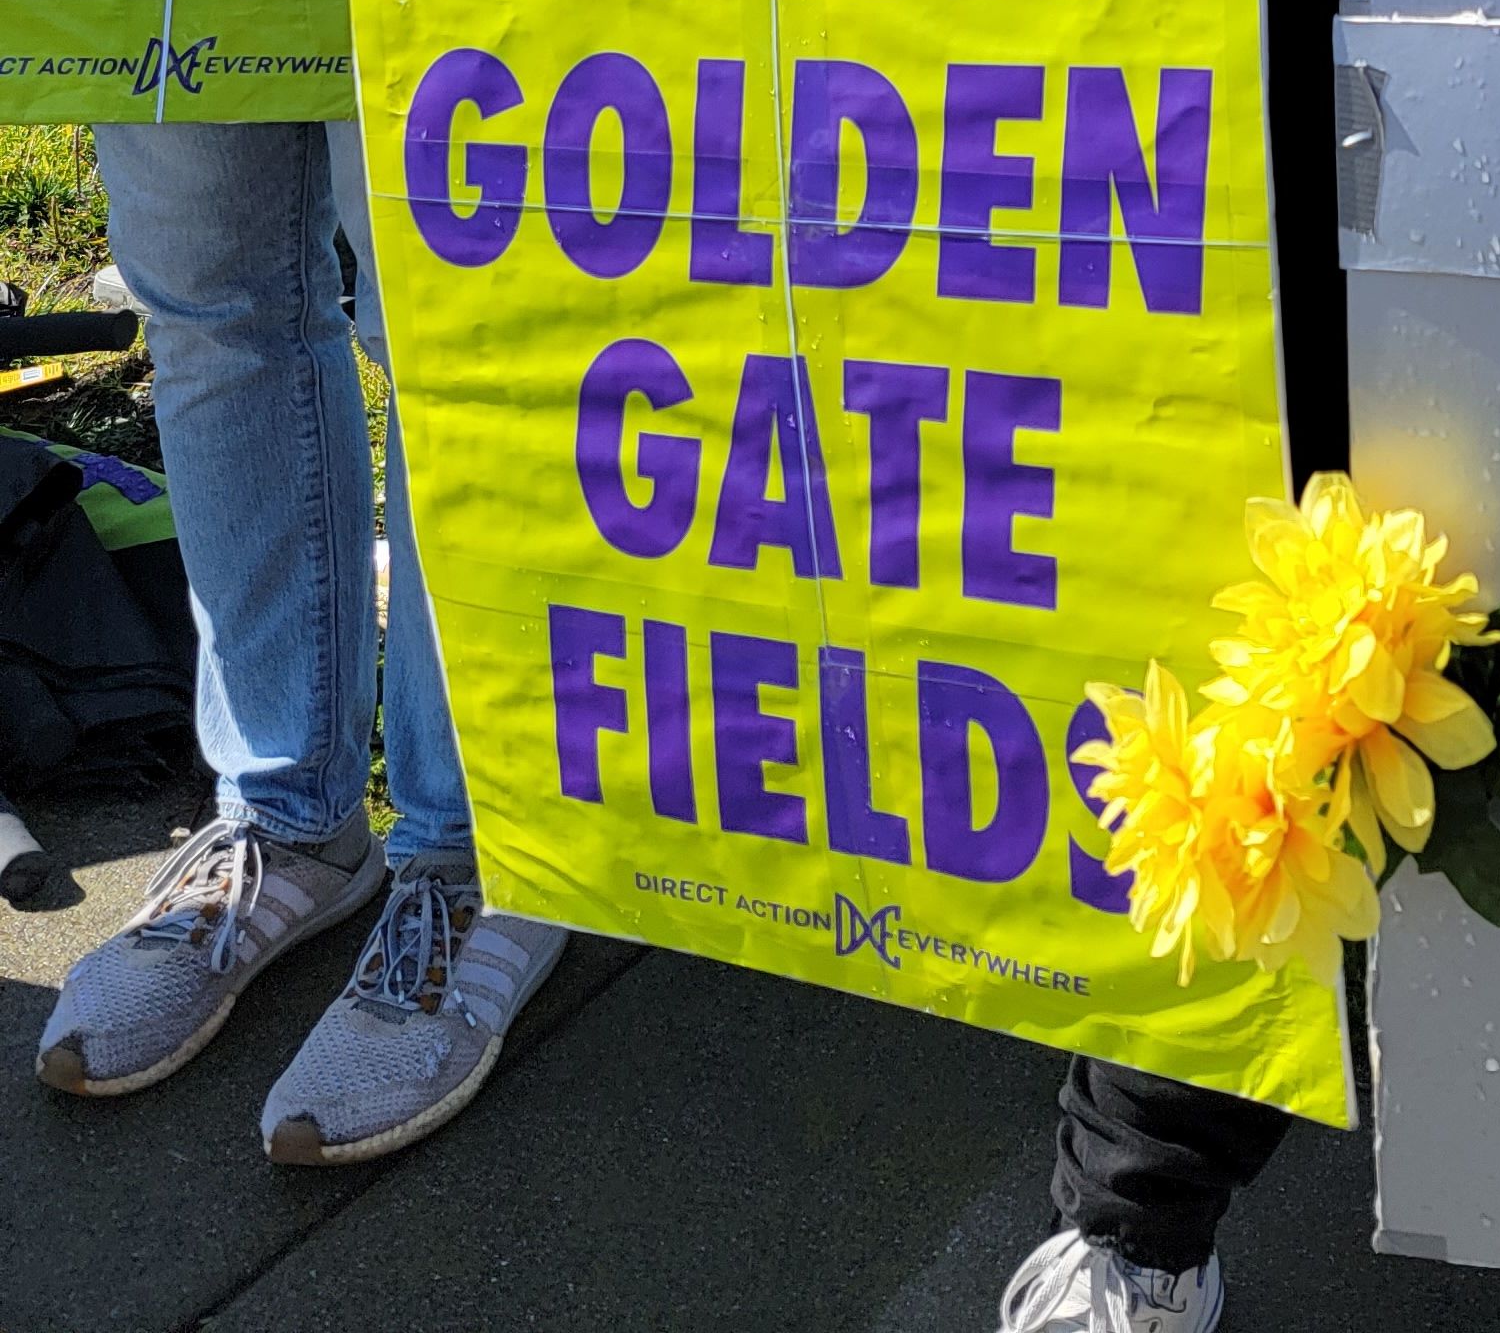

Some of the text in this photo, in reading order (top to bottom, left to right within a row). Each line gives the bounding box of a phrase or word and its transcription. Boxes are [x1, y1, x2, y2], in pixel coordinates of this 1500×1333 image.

[37, 57, 139, 76] ACTION
[204, 56, 356, 74] EVERYWHE
[404, 47, 1213, 315] GOLDEN
[575, 338, 1062, 611] GATE
[635, 872, 728, 906] DIRECT
[735, 893, 832, 931] ACTION
[899, 930, 1091, 996] EVERYWHERE
